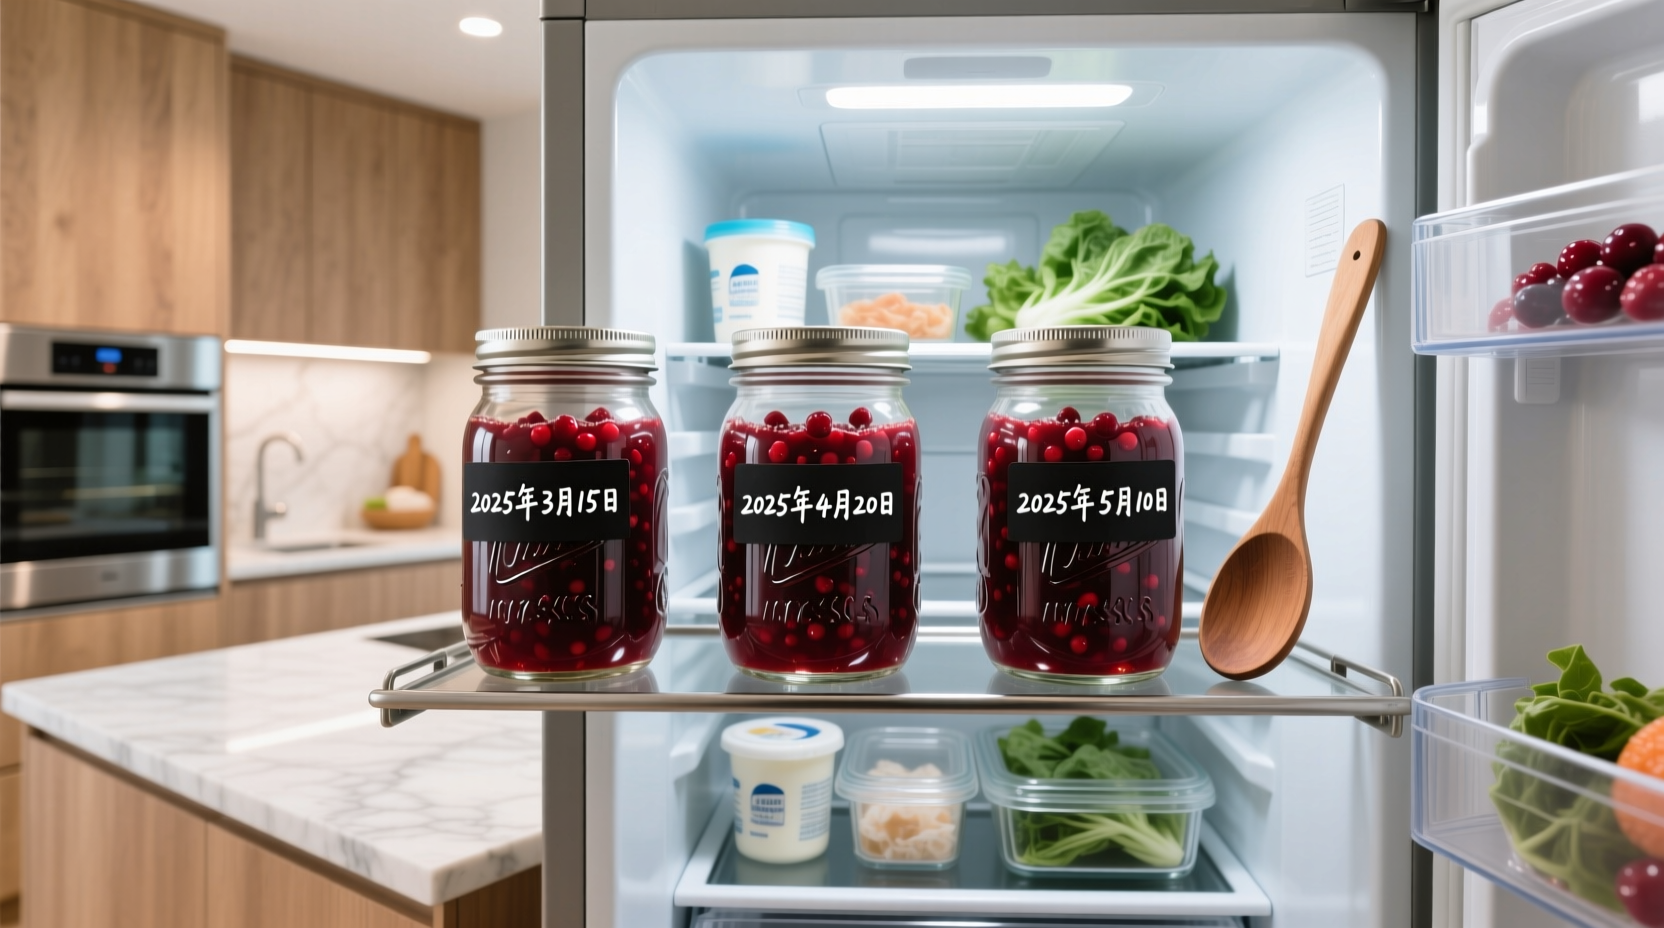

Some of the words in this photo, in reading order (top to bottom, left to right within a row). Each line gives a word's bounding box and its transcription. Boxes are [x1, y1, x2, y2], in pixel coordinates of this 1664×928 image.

[470, 483, 618, 522] 2025年3月15日
[740, 485, 893, 524] 2025年4月20日
[1016, 483, 1168, 523] 2025年5月10日
